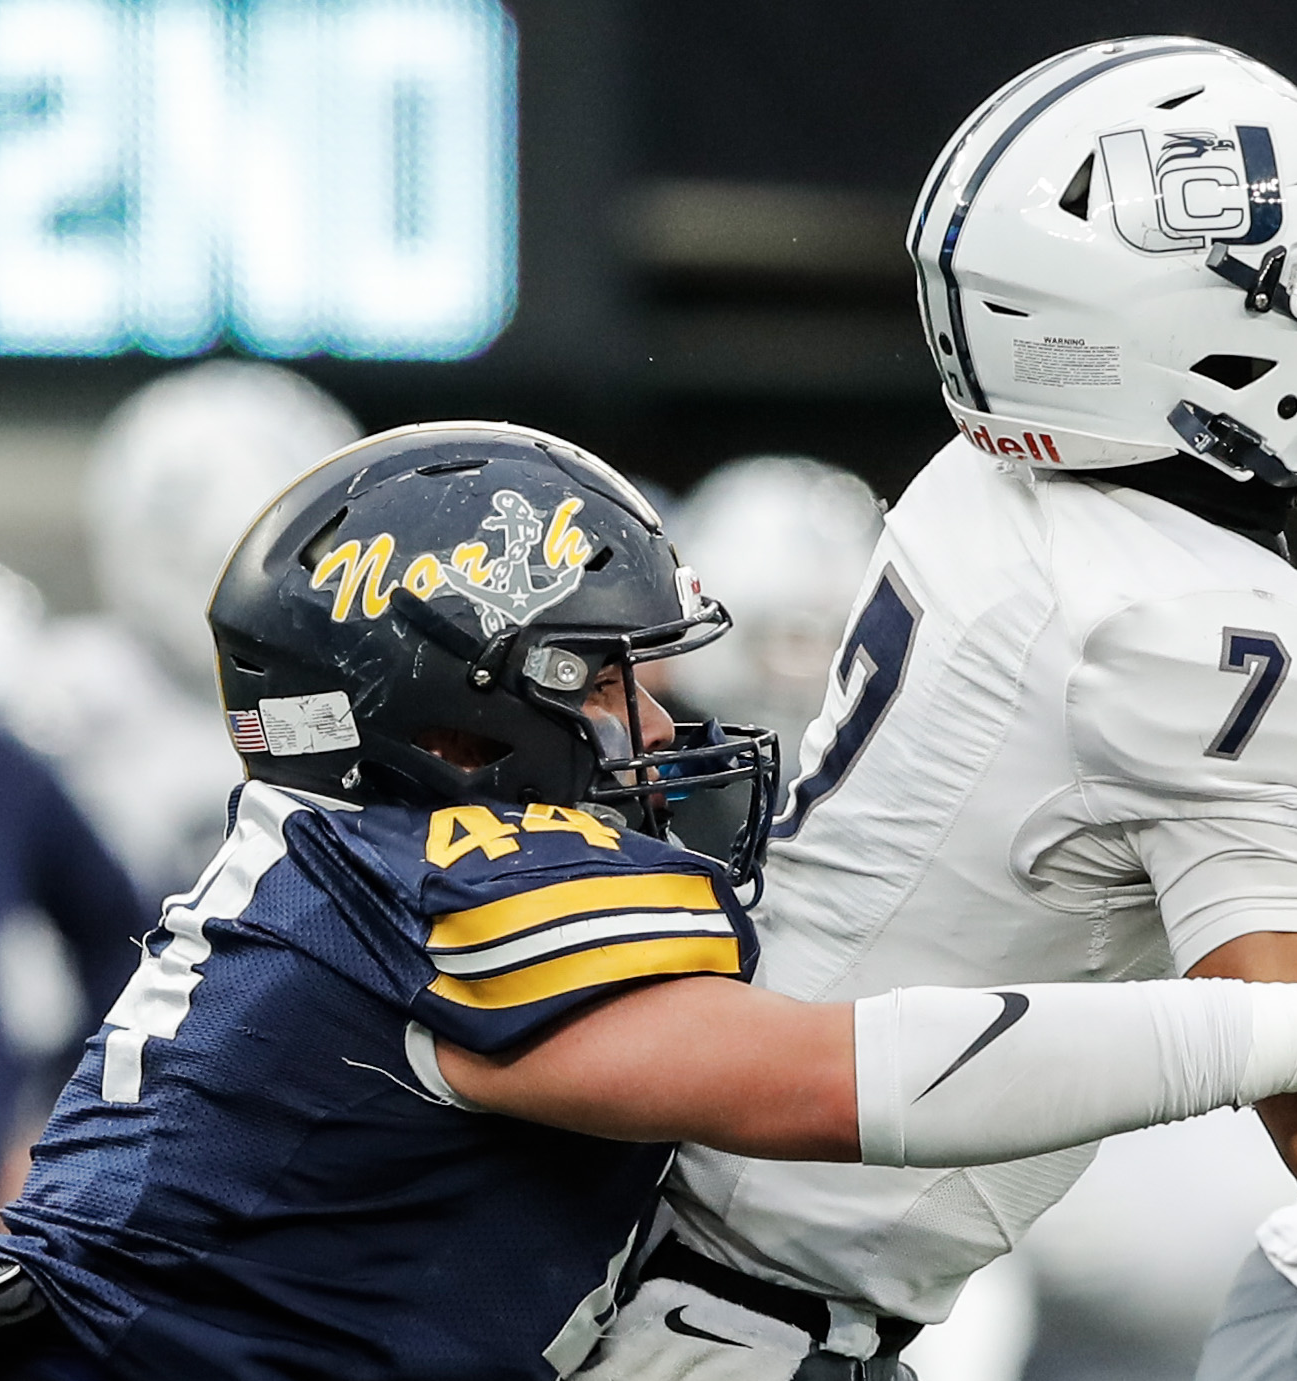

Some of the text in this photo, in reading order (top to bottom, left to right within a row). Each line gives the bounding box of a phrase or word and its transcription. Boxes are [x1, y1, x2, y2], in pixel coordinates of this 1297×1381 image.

[1043, 336, 1086, 346] WARNING
[767, 561, 924, 842] 7
[1203, 626, 1292, 761] 7
[425, 802, 622, 870] 44
